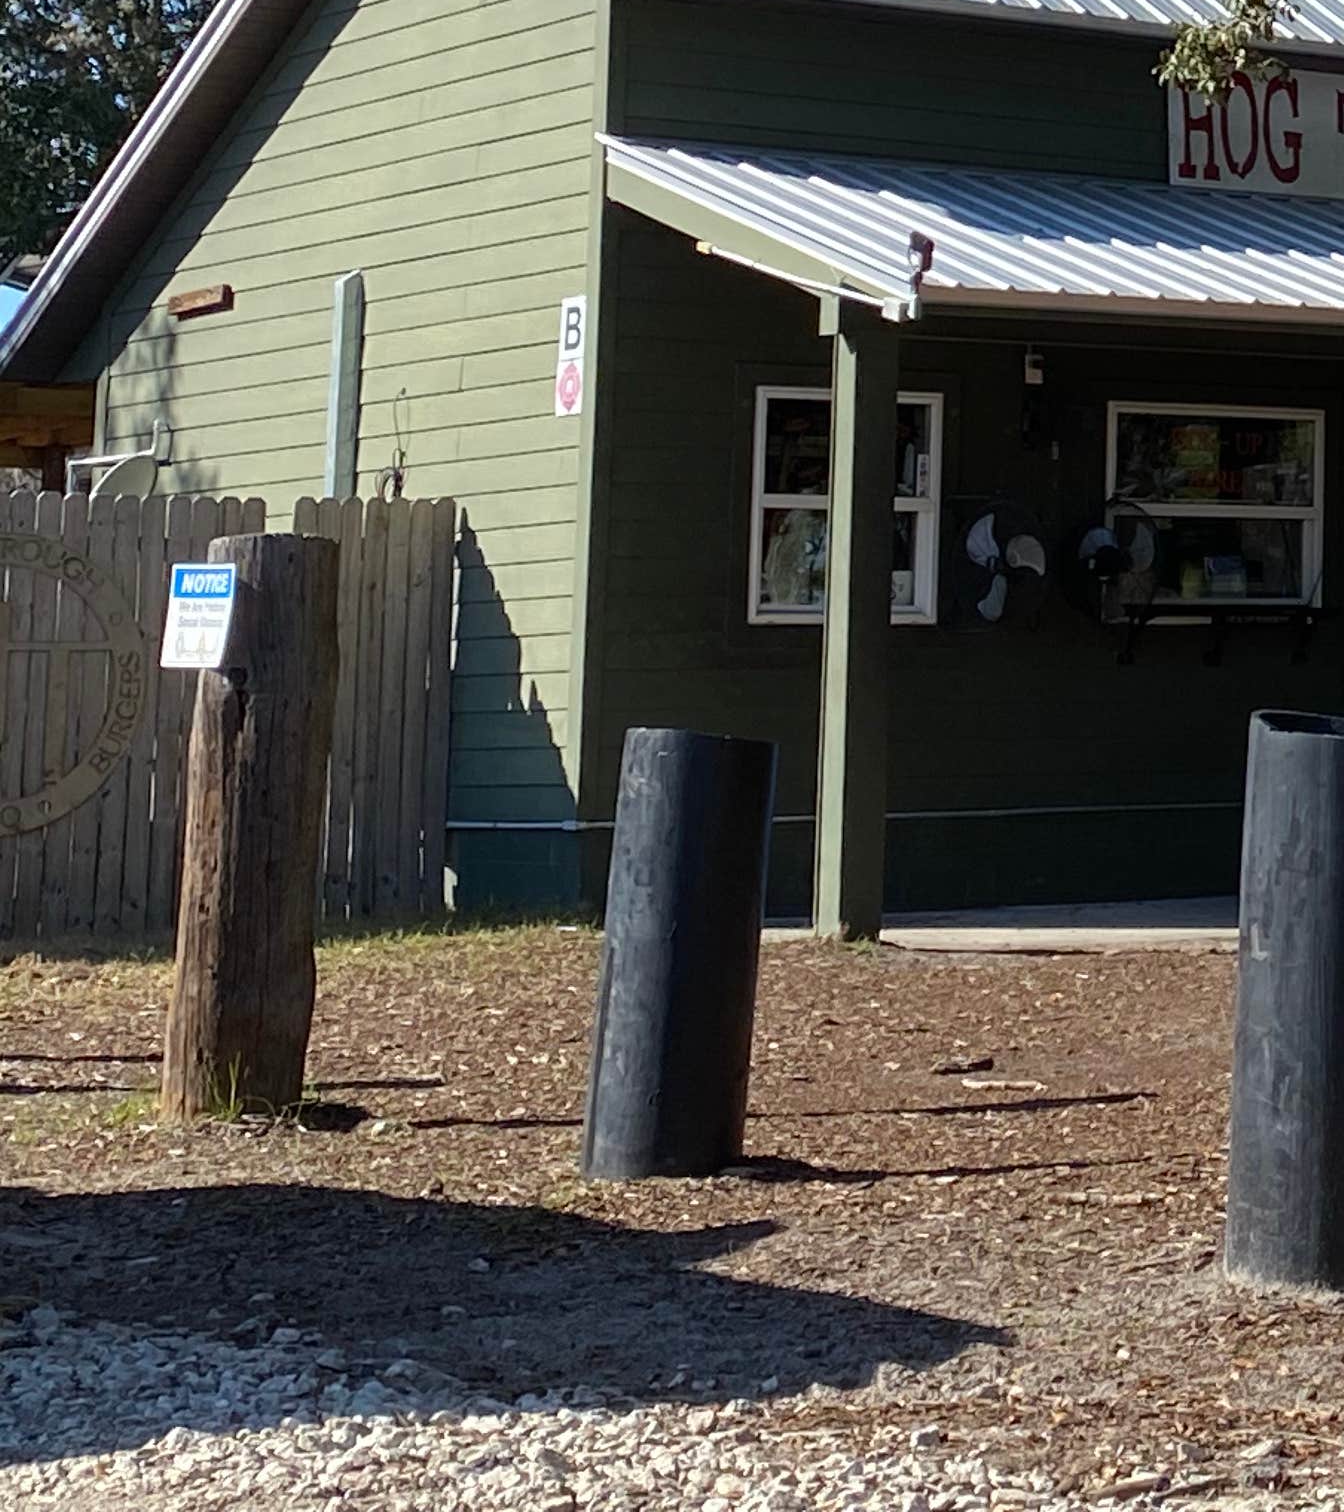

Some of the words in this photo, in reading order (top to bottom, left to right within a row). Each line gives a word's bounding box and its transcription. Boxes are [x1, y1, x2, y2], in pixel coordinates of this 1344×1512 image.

[1174, 71, 1303, 184] HOG
[565, 307, 581, 351] B
[181, 573, 229, 594] NOTICE
[88, 650, 141, 775] BURGERS
